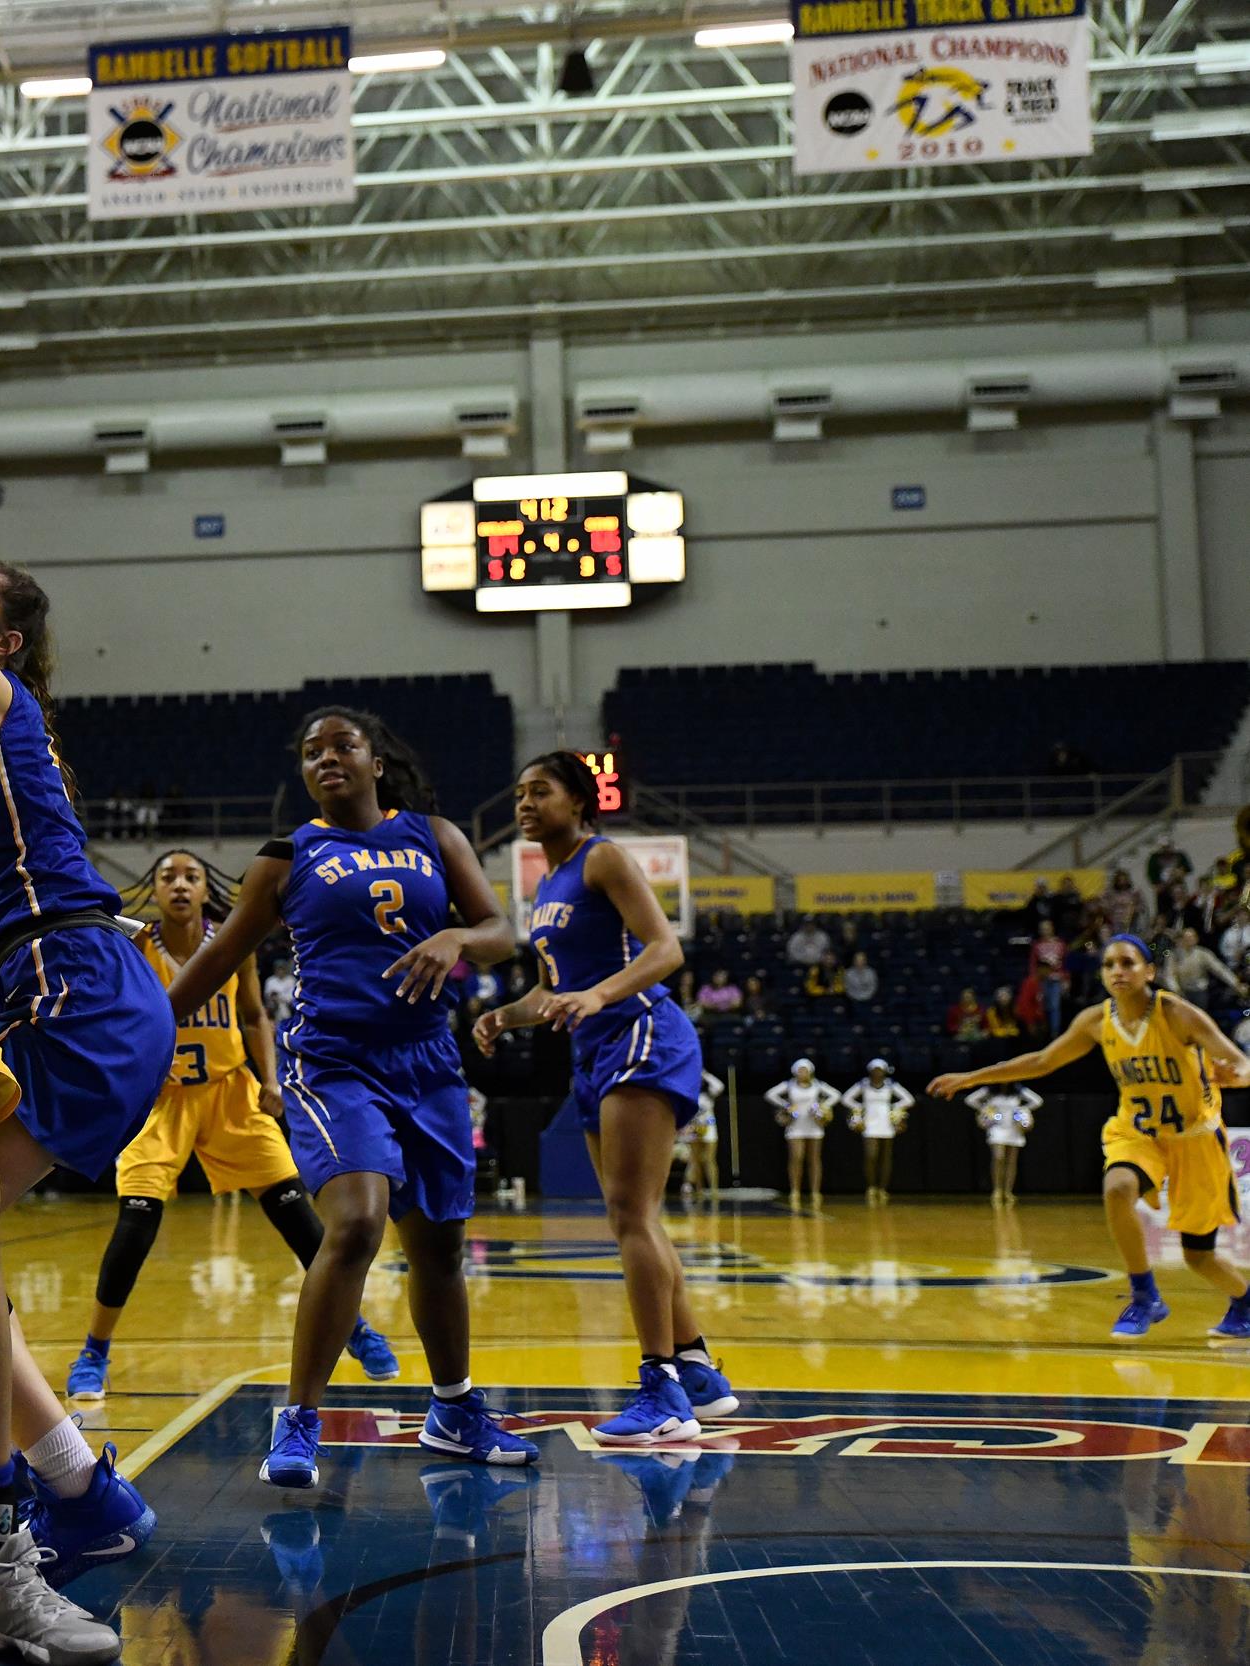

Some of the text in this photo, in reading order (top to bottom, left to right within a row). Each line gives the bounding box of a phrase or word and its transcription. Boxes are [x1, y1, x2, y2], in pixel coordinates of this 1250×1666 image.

[96, 36, 344, 83] RAMBELLE SOFTBALL
[808, 34, 1070, 88] NATIONAL CHAMPIONS
[187, 81, 342, 130] National
[186, 130, 349, 176] Champions
[314, 849, 433, 886] ST. MARY'S
[368, 879, 408, 935] 2
[176, 1043, 208, 1086] 3
[1111, 1055, 1183, 1086] ANGELO
[1130, 1094, 1184, 1138] 24
